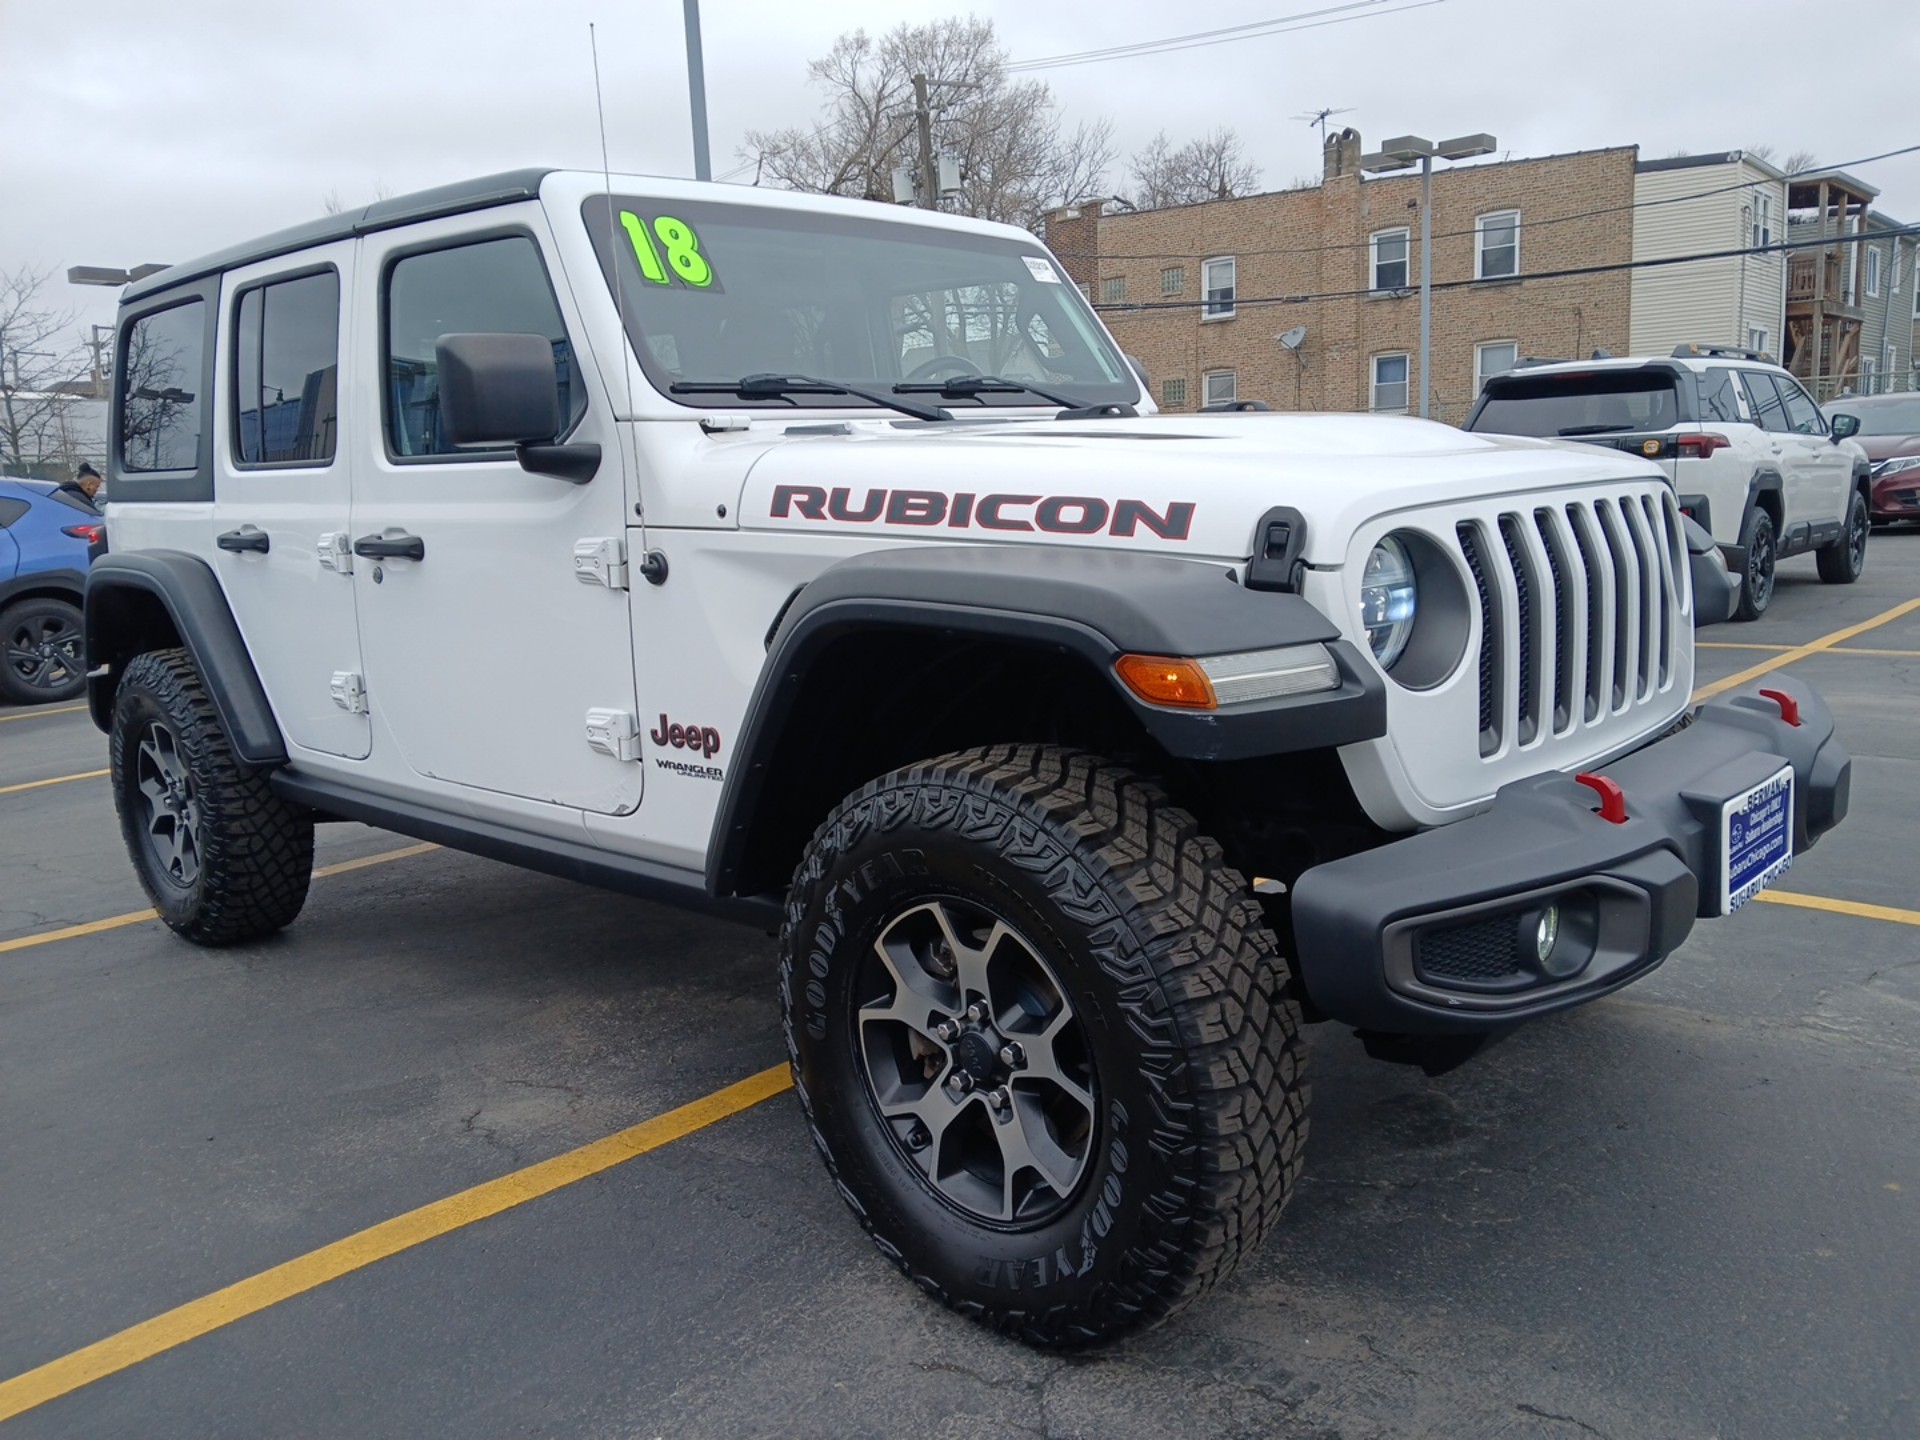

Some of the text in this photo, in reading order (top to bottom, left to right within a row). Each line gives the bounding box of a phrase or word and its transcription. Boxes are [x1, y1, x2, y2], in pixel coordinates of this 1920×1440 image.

[619, 209, 712, 288] 18
[769, 484, 1197, 541] RUBICON
[650, 713, 721, 759] Jeep
[655, 758, 724, 777] WRANGLER
[677, 770, 724, 782] UNLIMITED
[1747, 778, 1781, 809] BERMAN
[1762, 854, 1792, 889] CHICAGO
[1730, 877, 1761, 912] SUBARU
